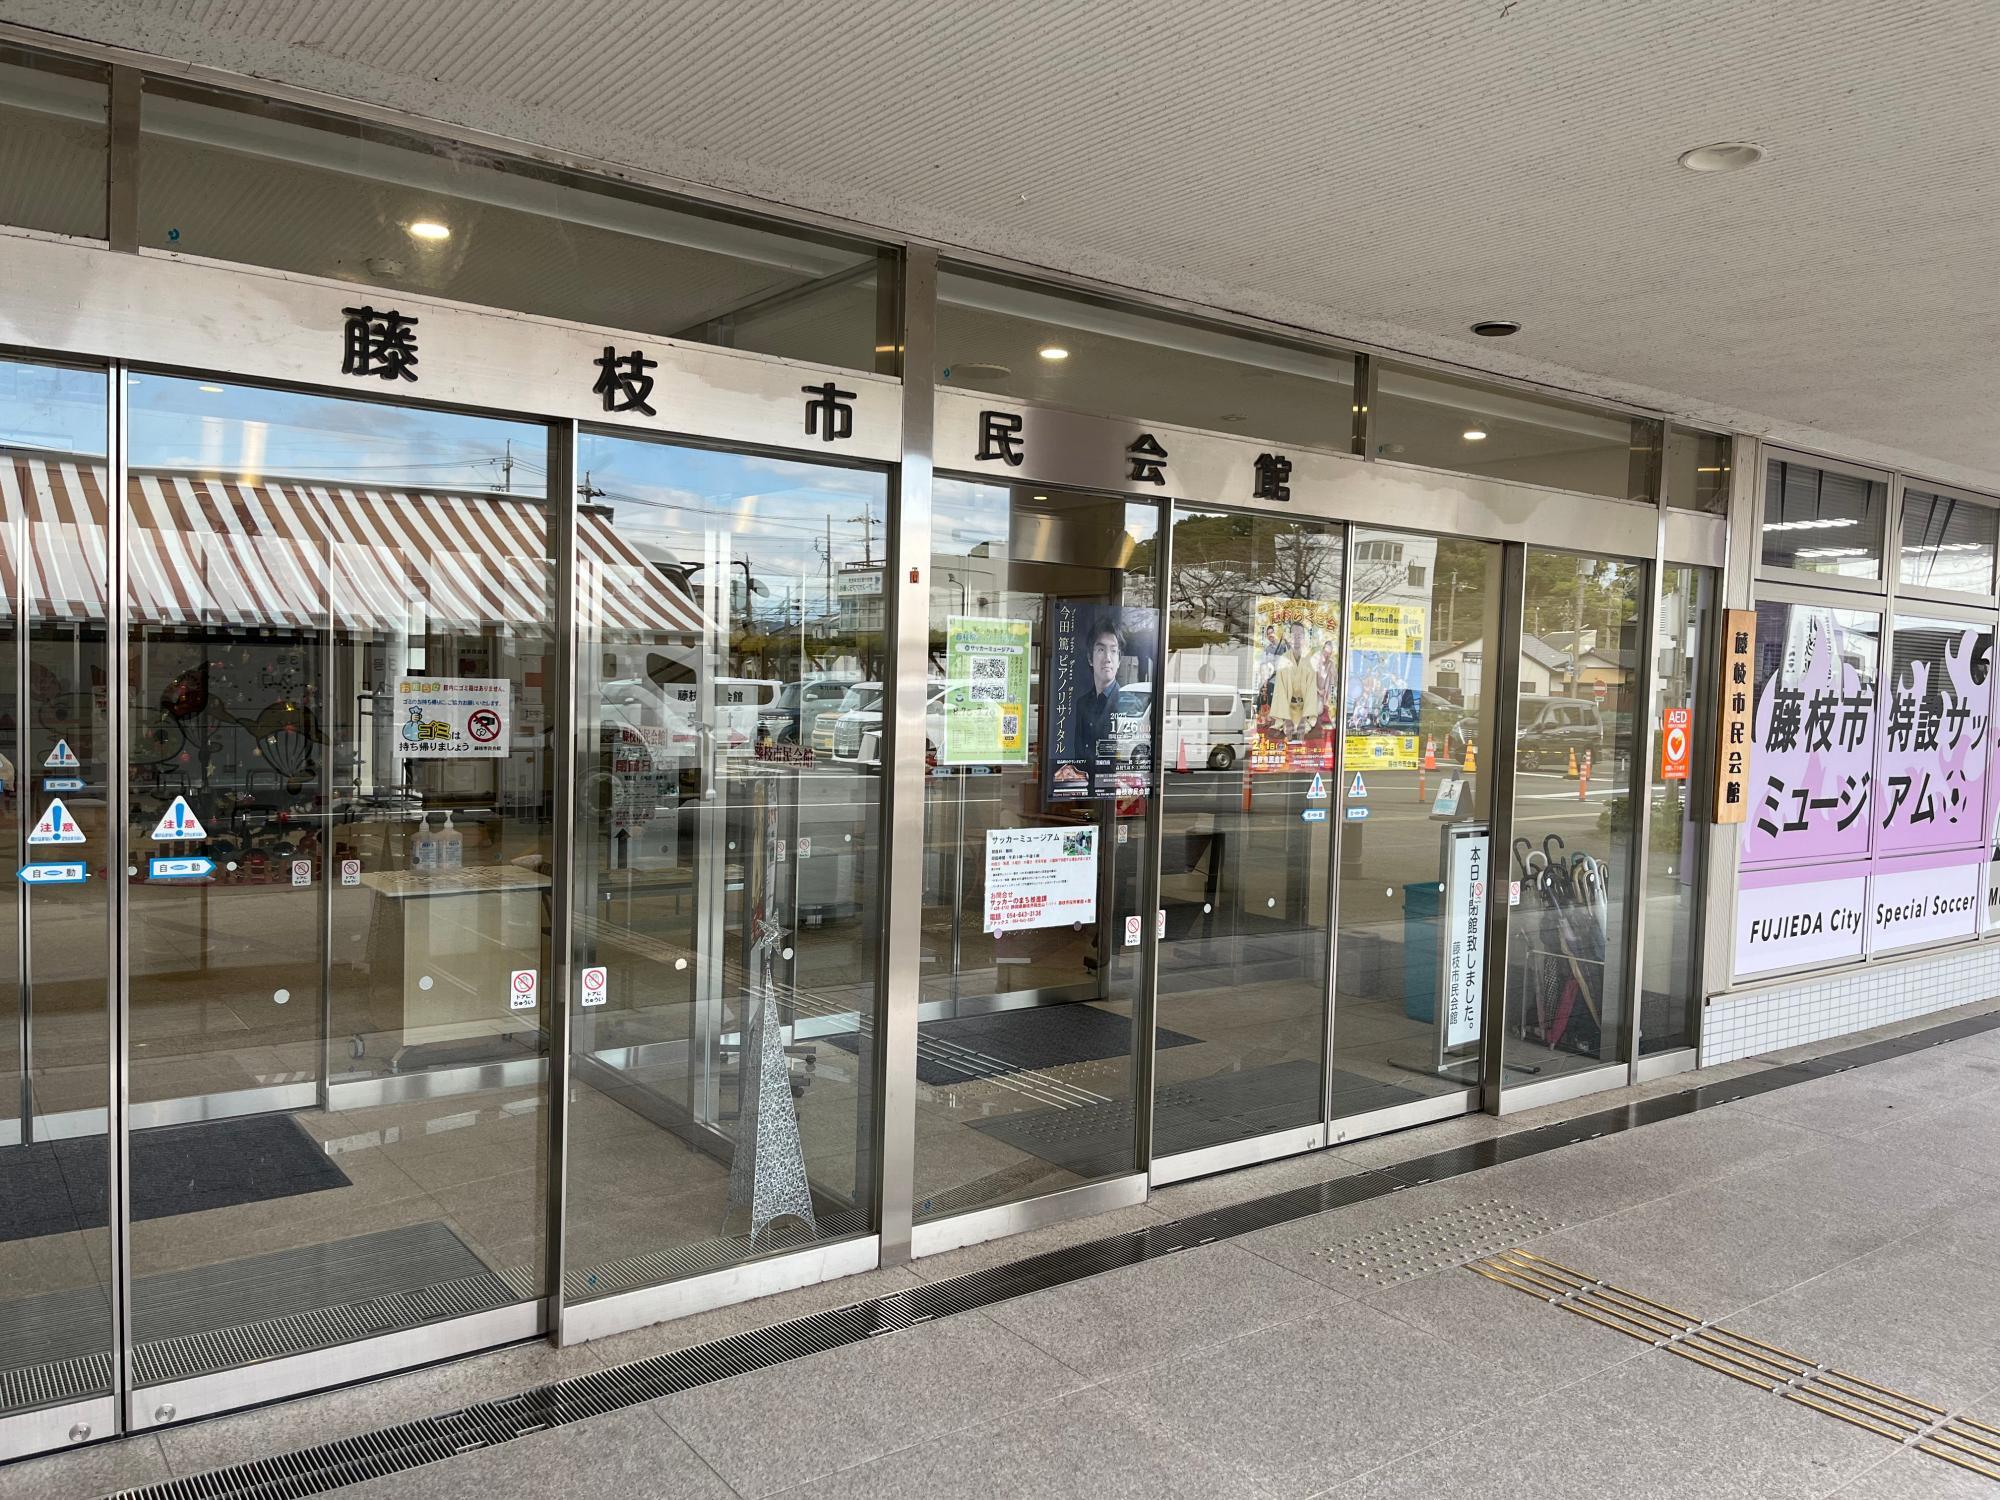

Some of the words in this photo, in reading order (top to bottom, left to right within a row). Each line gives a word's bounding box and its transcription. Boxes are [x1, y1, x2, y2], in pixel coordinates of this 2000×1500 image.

[970, 644, 1015, 653] サッカーミュージアム
[1668, 711, 1688, 723] AED
[1726, 631, 1750, 805] 藤枝市民会館
[1110, 720, 1138, 734] 1/26
[399, 742, 470, 752] 持ち帰りましょう
[40, 822, 74, 833] 注意
[163, 819, 196, 829] 注意
[992, 833, 1060, 844] サッカーミュージアム
[159, 862, 201, 873] 自動
[32, 868, 76, 879] 自動
[1750, 913, 1823, 944] FUJIEDA
[1830, 908, 1862, 933] City
[1876, 895, 1928, 927] Special
[1932, 893, 1976, 917] Soccer
[1988, 887, 2000, 907] M
